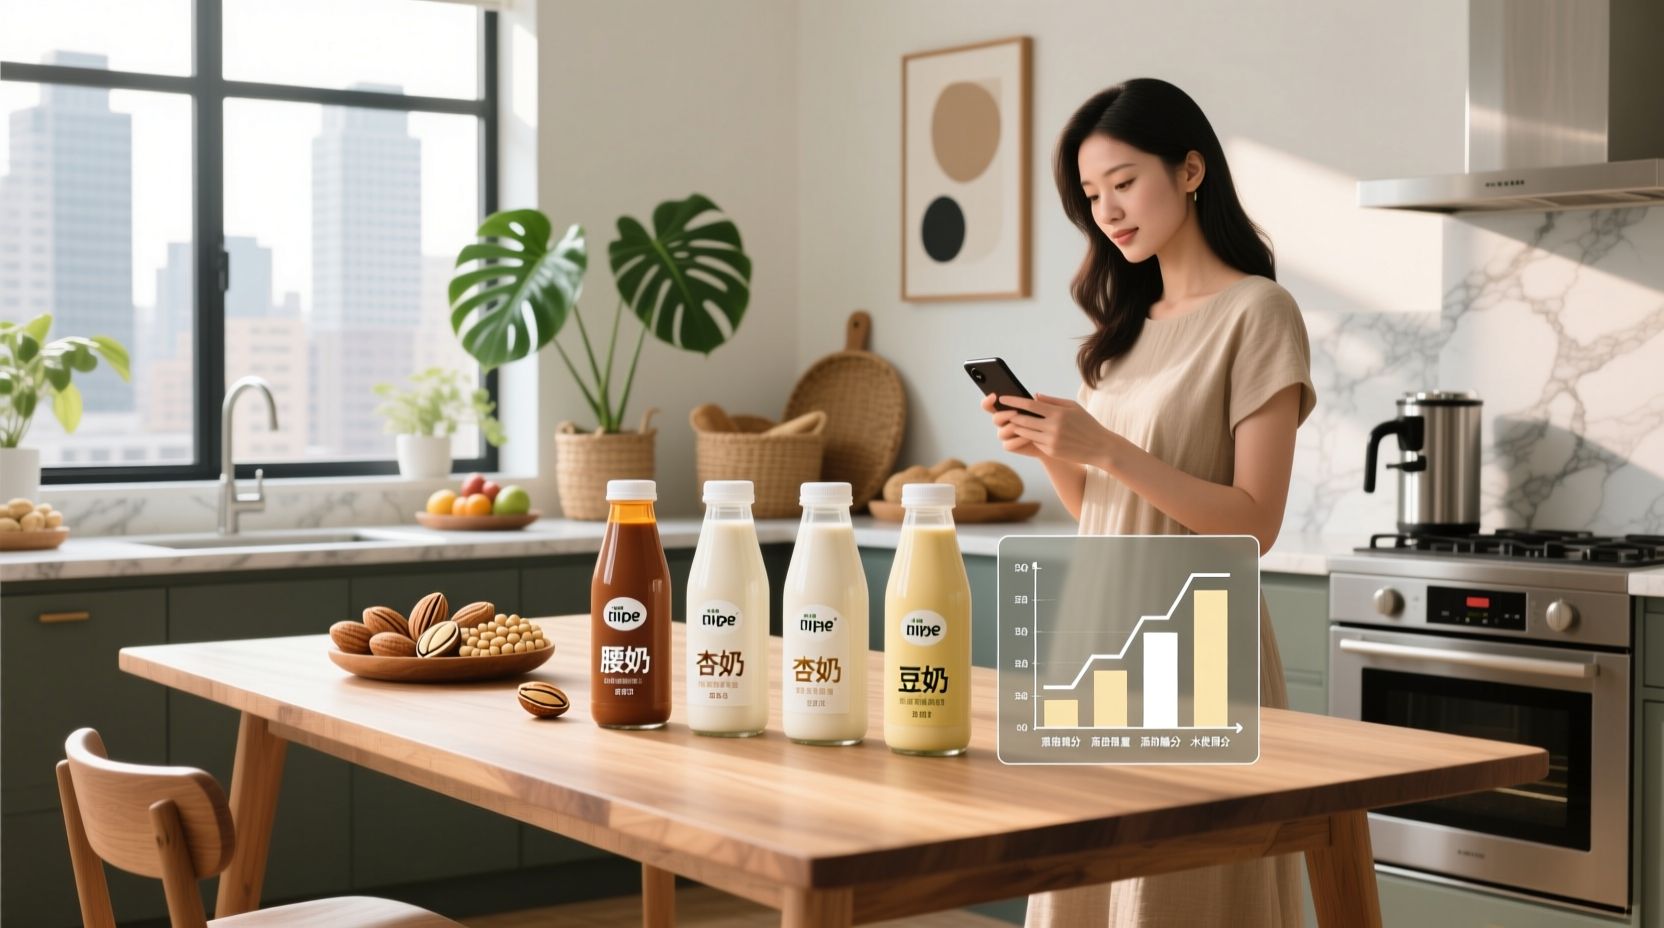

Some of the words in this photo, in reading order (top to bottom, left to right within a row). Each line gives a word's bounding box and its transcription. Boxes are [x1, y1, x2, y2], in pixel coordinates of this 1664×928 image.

[600, 645, 650, 674] 腰奶
[696, 649, 744, 677] 杏奶
[793, 655, 841, 683] 杏奶
[898, 665, 948, 693] 豆奶
